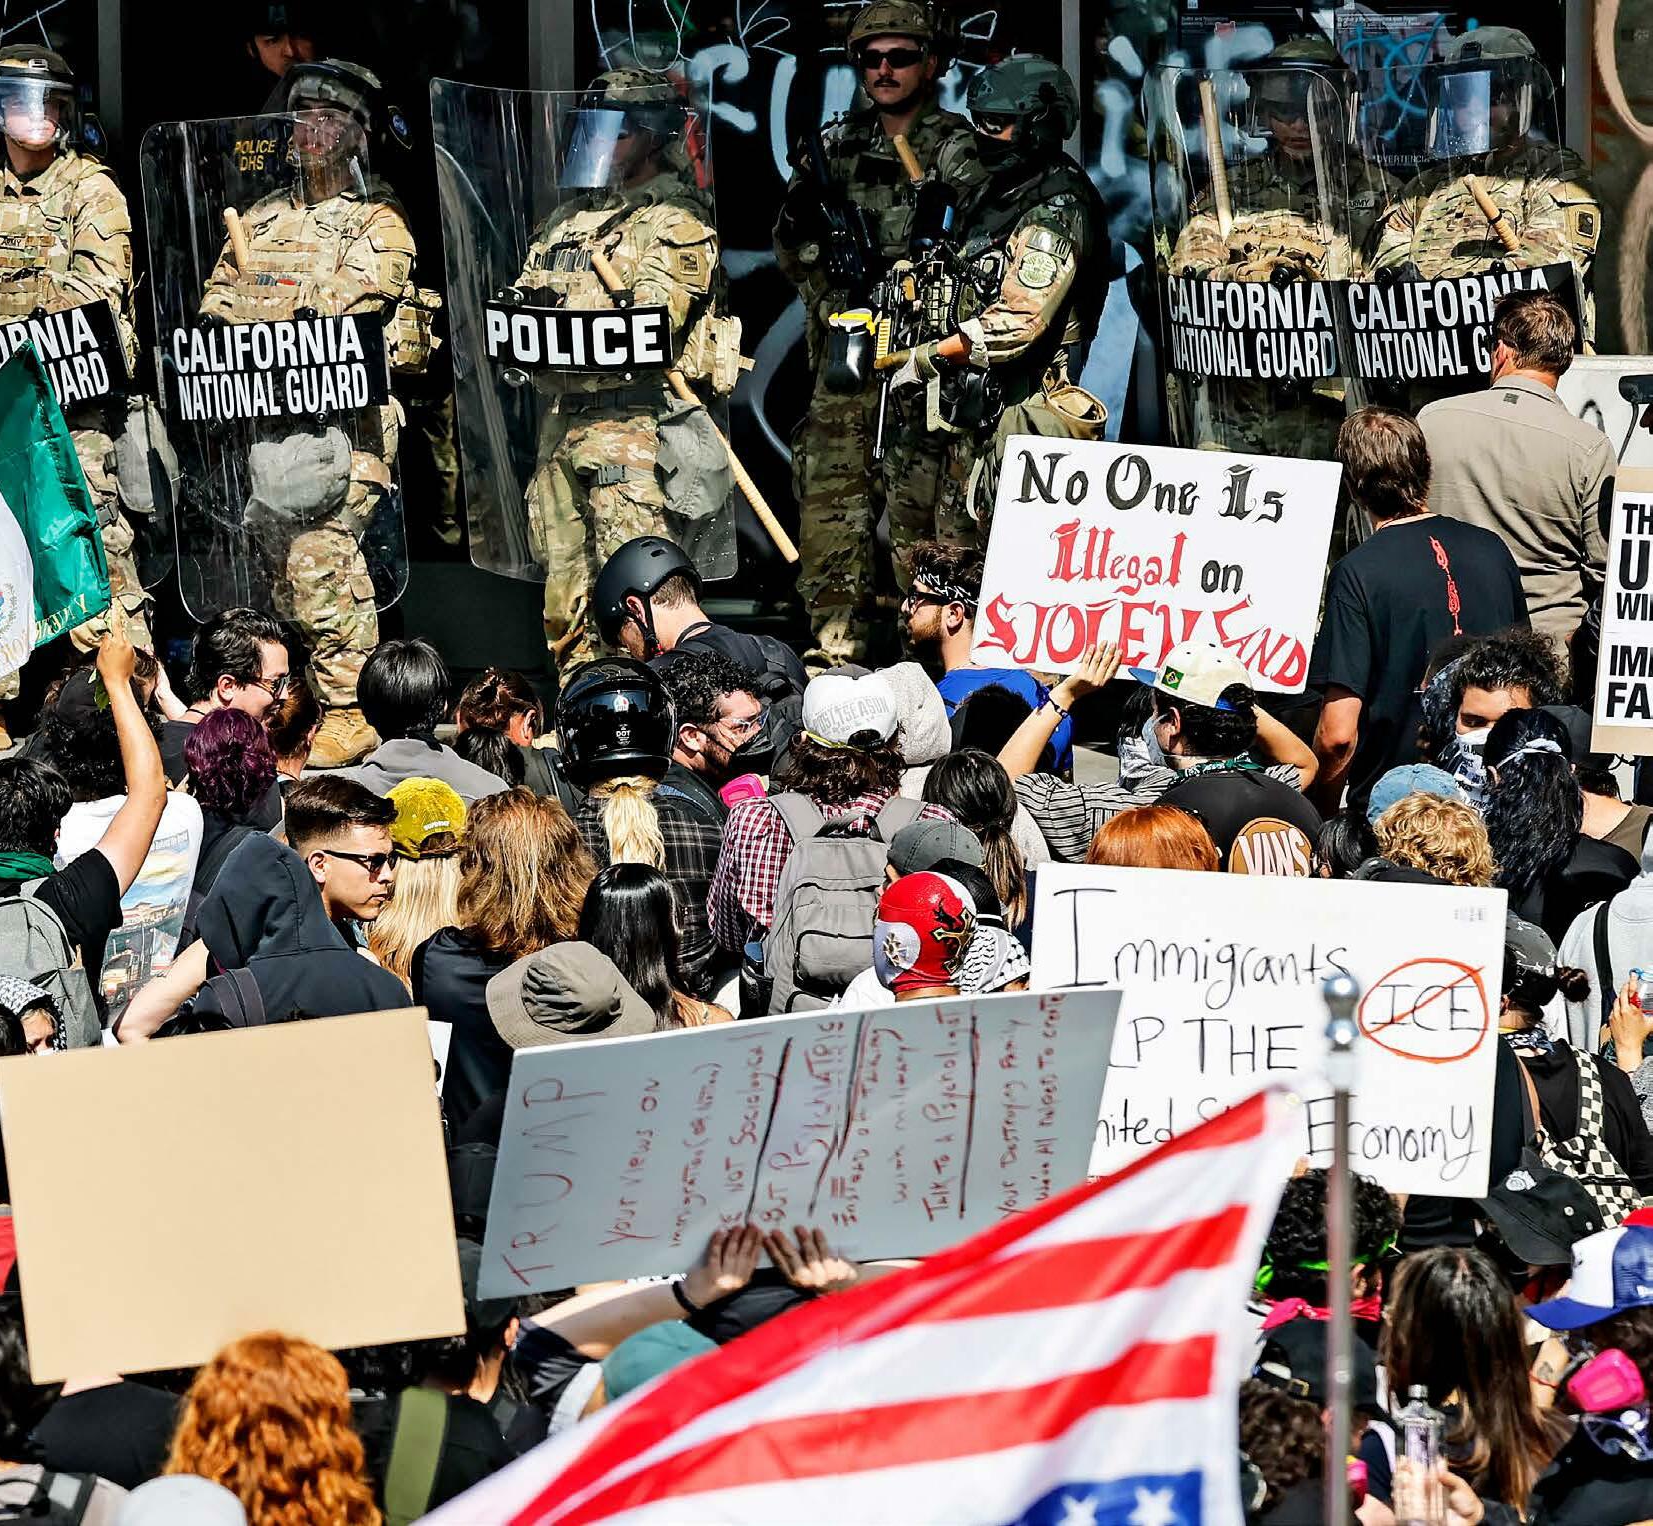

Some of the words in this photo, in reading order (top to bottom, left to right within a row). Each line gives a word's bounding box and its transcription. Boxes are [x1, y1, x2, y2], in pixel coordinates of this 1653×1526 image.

[235, 140, 277, 153] POLICE
[240, 155, 264, 171] DHS
[0, 236, 22, 248] ARMY
[1168, 276, 1335, 330] CALIFORNIA
[173, 316, 365, 374] CALIFORNIA
[486, 309, 663, 366] POLICE
[1172, 326, 1251, 378] NATIONAL
[1256, 331, 1336, 378] GUARD
[1355, 329, 1469, 378] NATIONAL
[178, 371, 282, 422] NATIONAL
[286, 363, 369, 414] GUARD
[1011, 450, 1088, 506] No
[1105, 453, 1200, 517] One
[1217, 463, 1288, 524] Is
[1048, 517, 1189, 596] Illegal
[1201, 560, 1244, 594] on
[1238, 827, 1310, 878] VANS
[1049, 887, 1351, 1010] Immigrants
[1369, 984, 1488, 1032] ICE
[1183, 1017, 1304, 1075] THE
[1094, 1097, 1174, 1148] nited
[502, 1077, 608, 1287] TRUMP
[724, 1156, 745, 1193] NOT
